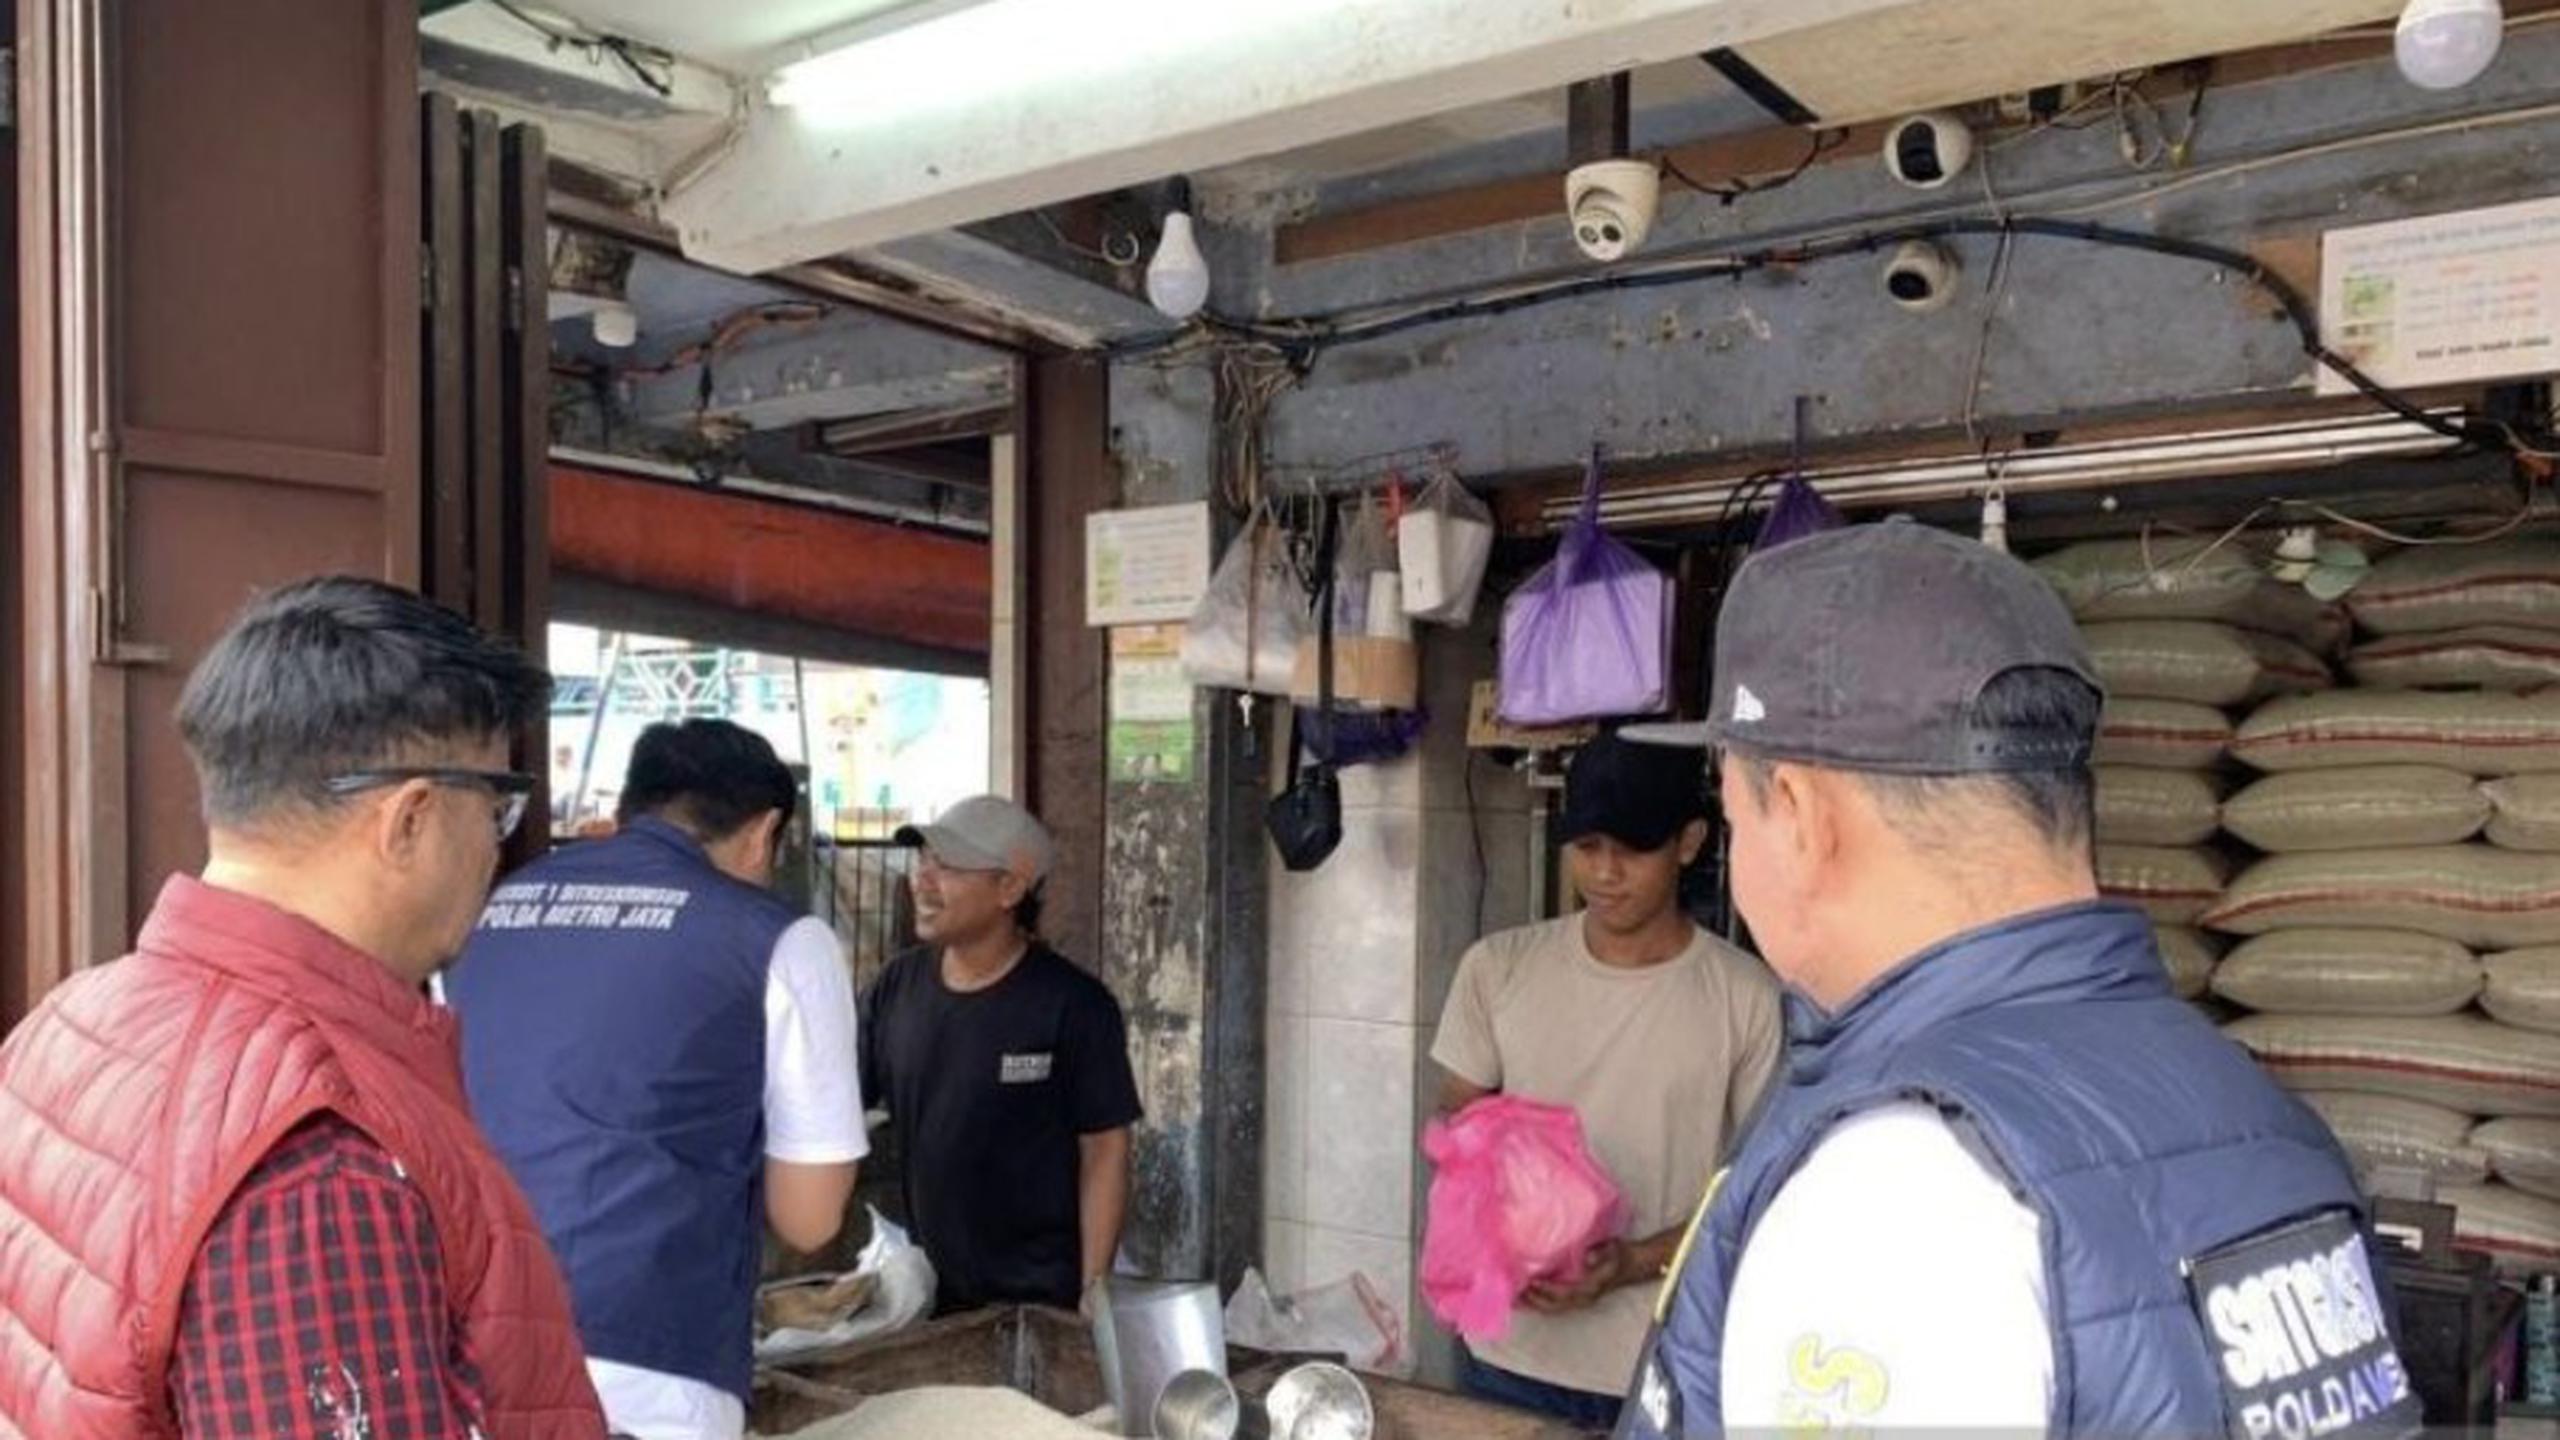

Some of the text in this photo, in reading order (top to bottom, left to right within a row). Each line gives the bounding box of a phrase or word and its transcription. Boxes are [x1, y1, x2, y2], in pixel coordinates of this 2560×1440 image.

[477, 903, 676, 931] POLDA METRO JAYA
